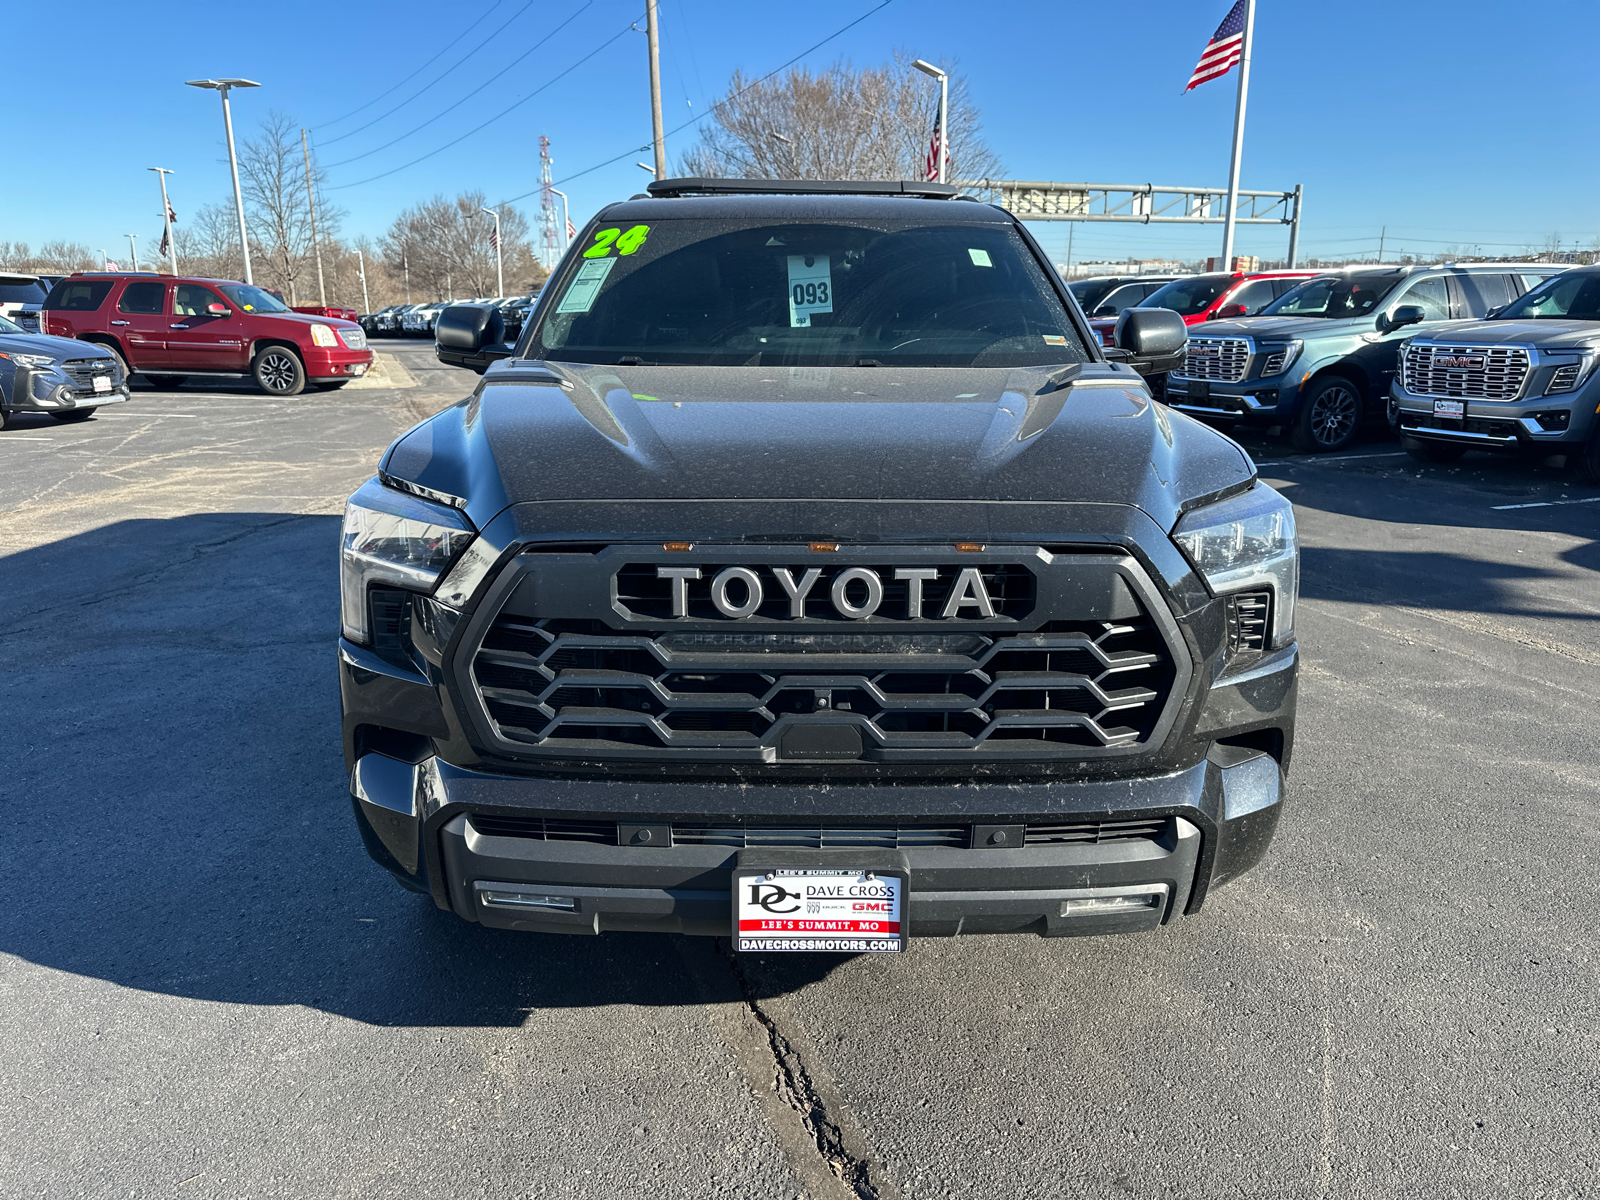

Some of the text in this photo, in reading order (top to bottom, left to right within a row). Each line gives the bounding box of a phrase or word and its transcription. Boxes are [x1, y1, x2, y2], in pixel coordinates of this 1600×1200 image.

[583, 225, 650, 258] 24
[793, 282, 829, 305] 093
[1434, 356, 1483, 368] GMC
[657, 566, 997, 619] TOYOTA
[806, 886, 894, 897] DAVE CROSS
[852, 902, 893, 912] GMC
[761, 920, 879, 931] LEE'S SUMMIT, MO
[741, 939, 899, 951] DAVECROSSMOTORS.COM
